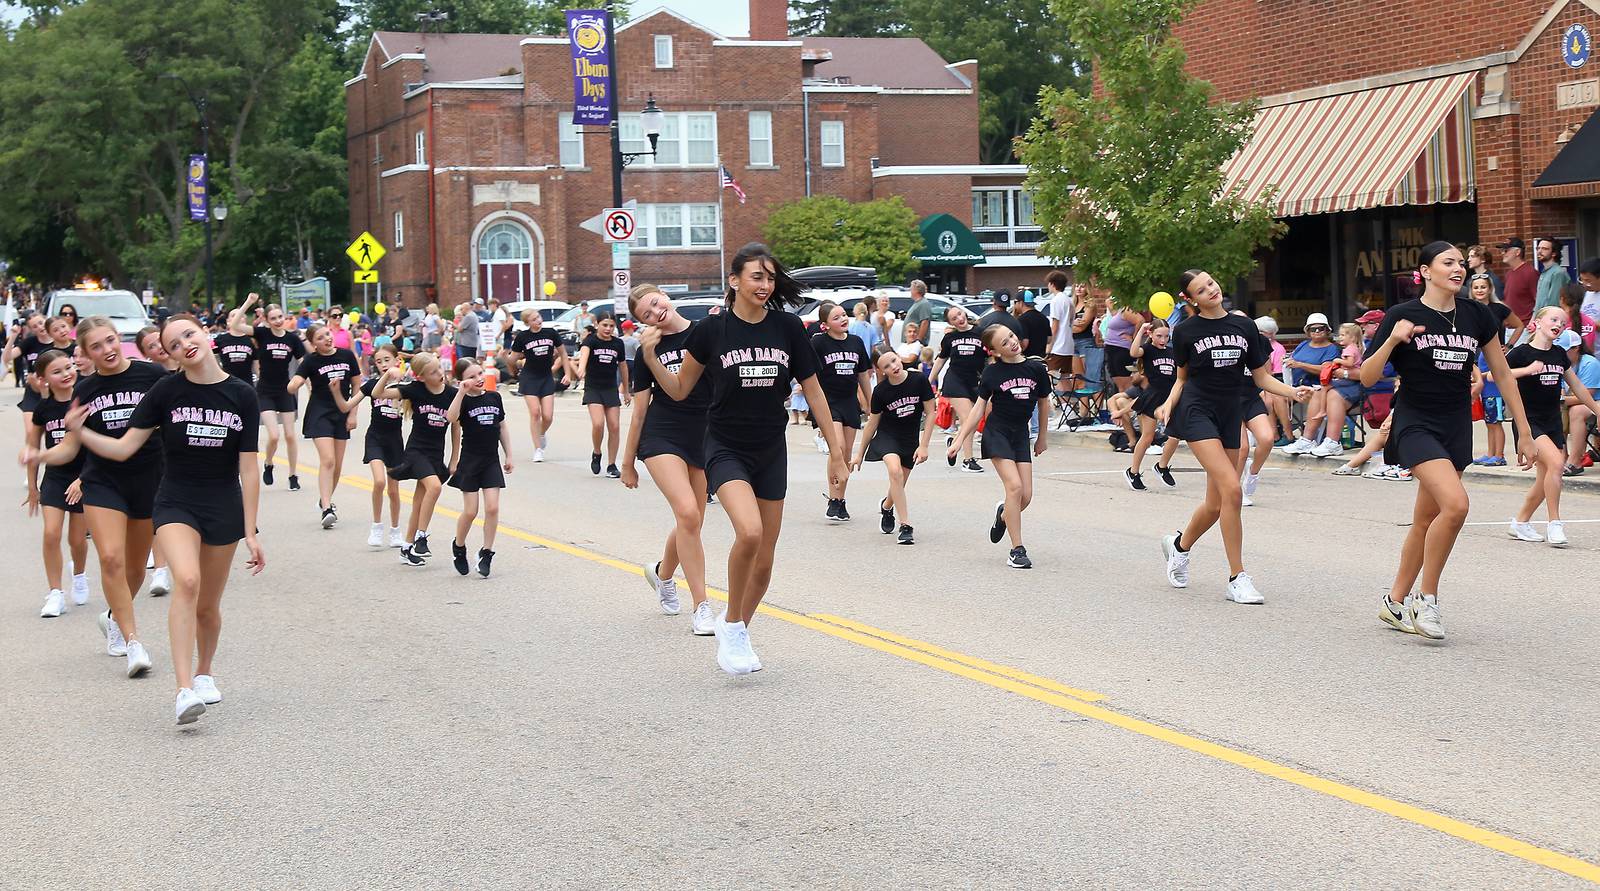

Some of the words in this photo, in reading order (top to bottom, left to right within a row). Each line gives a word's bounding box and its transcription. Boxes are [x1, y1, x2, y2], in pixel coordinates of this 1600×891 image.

[575, 57, 609, 77] Elburn
[582, 77, 606, 103] Days
[761, 367, 777, 375] 2003
[209, 427, 226, 436] 2003
